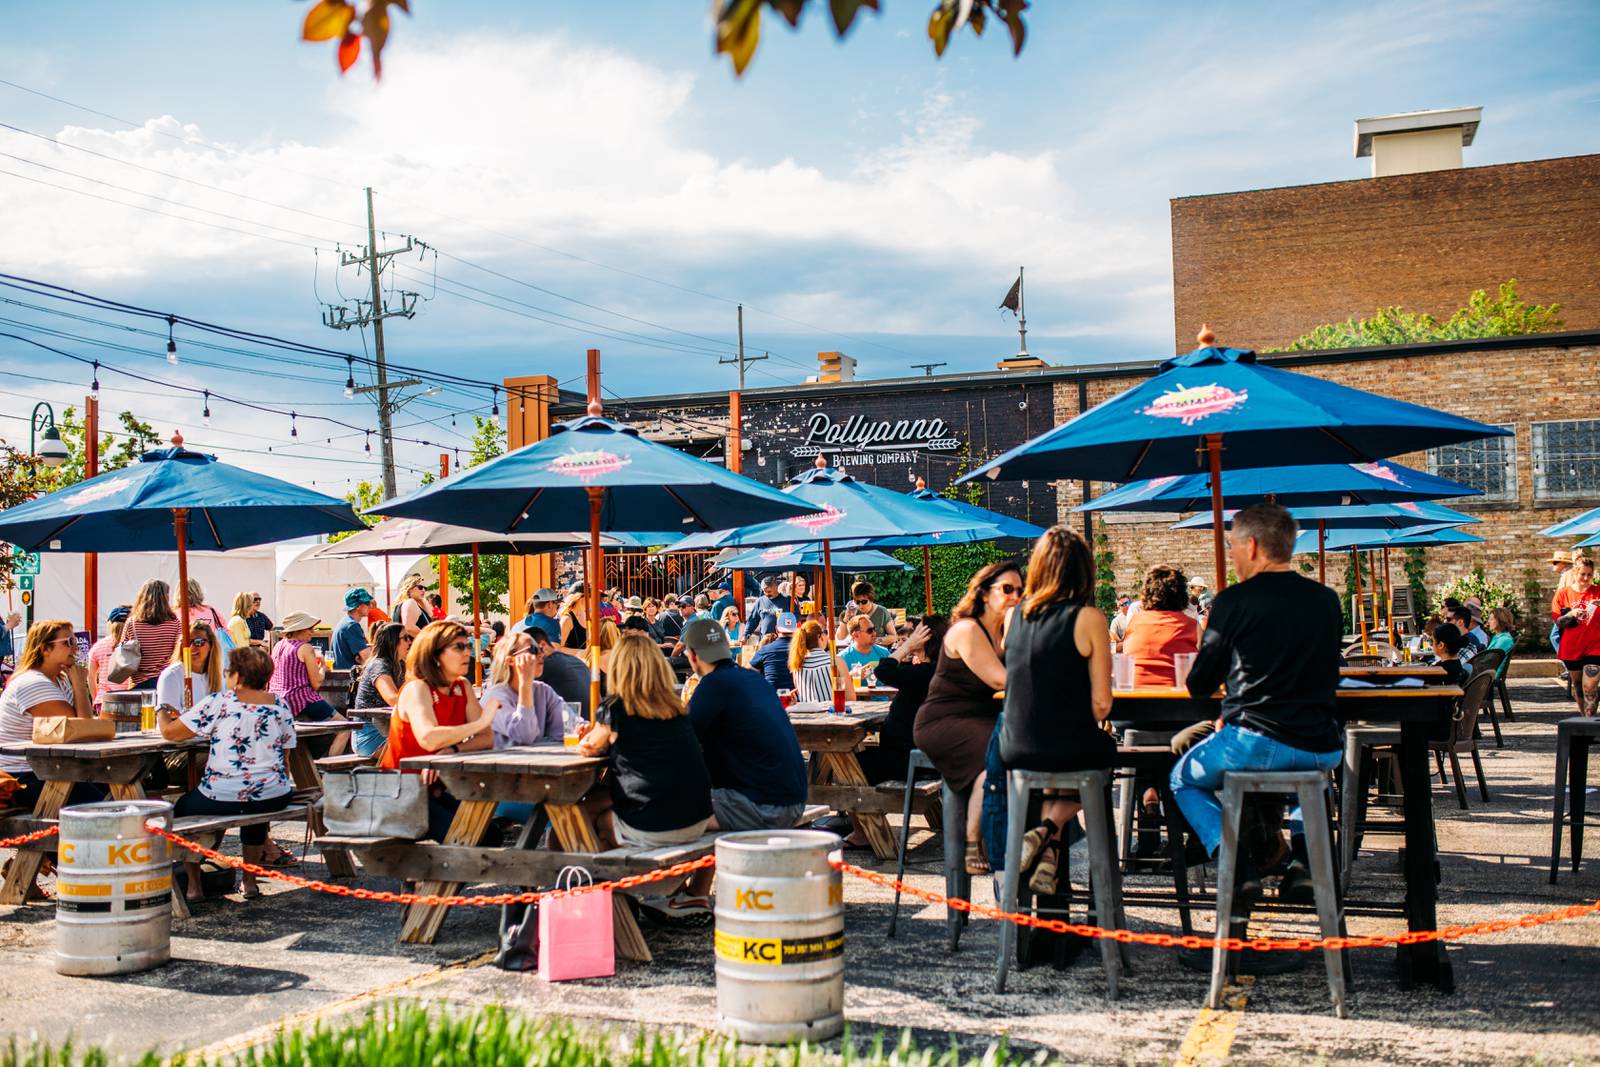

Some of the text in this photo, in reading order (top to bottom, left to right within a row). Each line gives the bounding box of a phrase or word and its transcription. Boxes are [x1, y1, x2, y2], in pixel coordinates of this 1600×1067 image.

[804, 412, 948, 452] Pollyanna
[833, 450, 919, 467] BREWING COMPANY
[58, 843, 75, 864] C
[108, 842, 152, 865] KC
[735, 887, 774, 910] KC
[744, 941, 776, 960] KC
